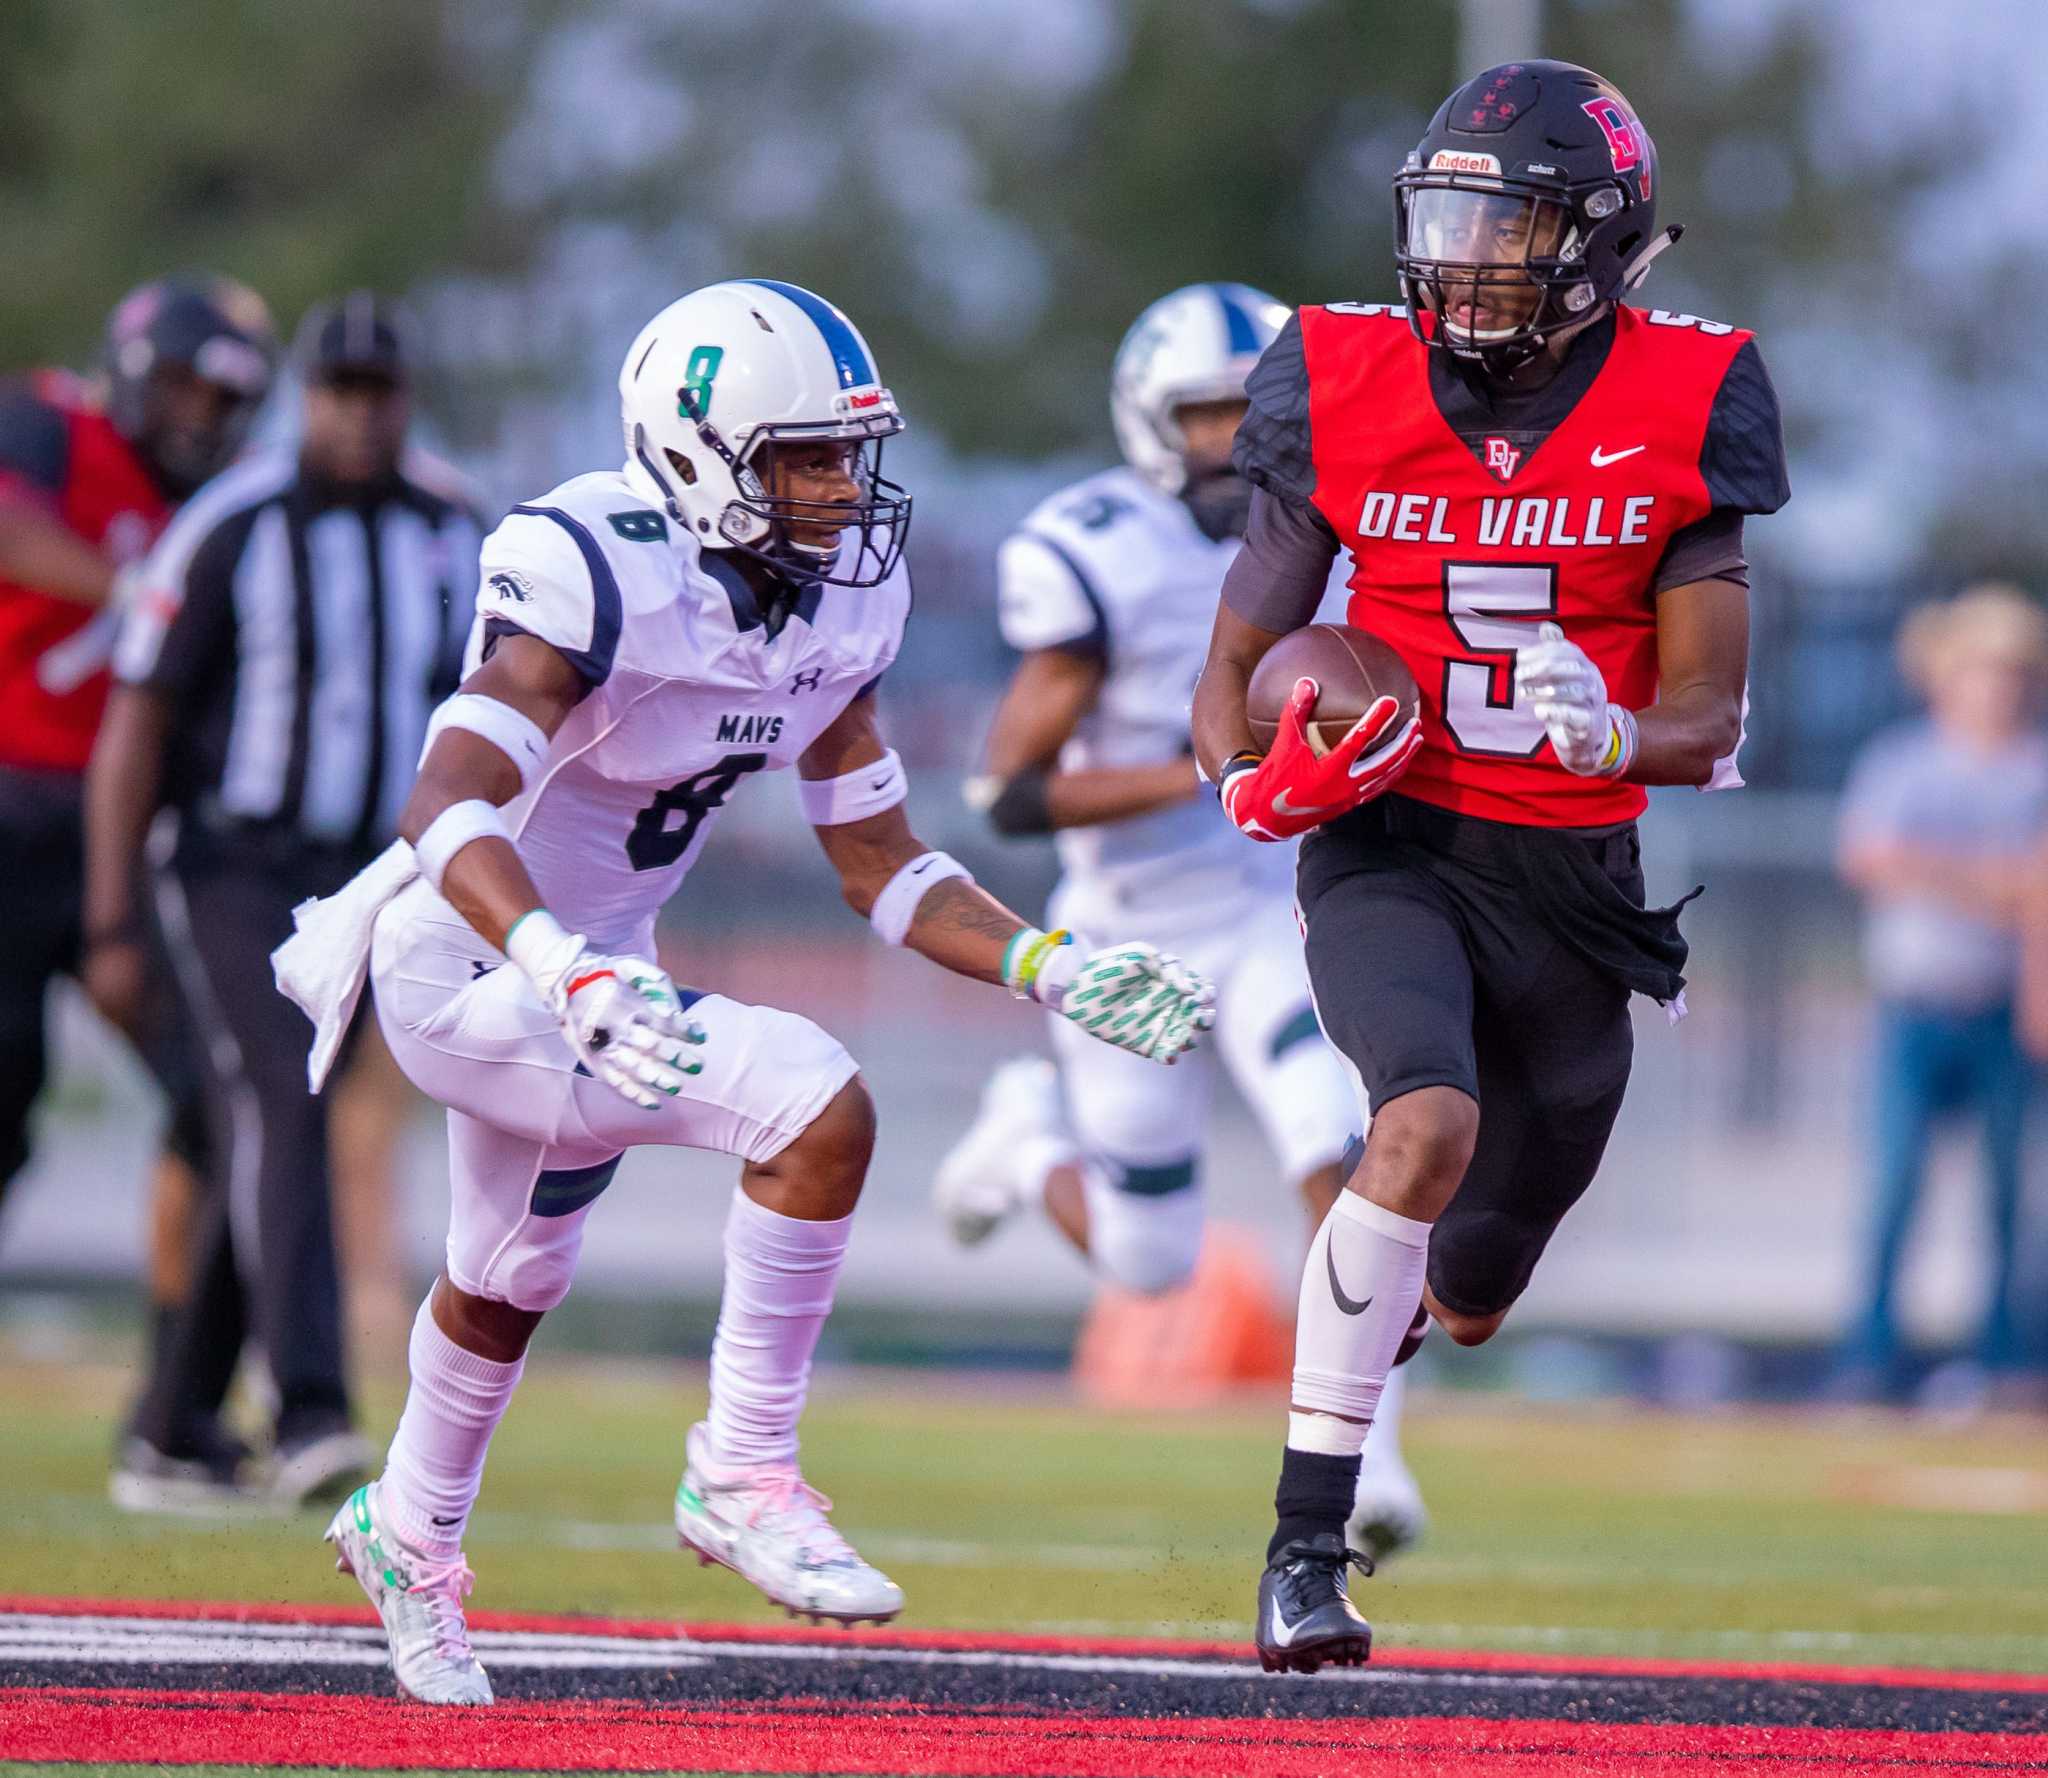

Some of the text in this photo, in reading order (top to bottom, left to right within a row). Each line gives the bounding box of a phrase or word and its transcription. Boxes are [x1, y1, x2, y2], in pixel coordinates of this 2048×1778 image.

[1435, 154, 1490, 171] Riddell
[675, 345, 724, 418] 8
[1486, 438, 1520, 479] DV
[607, 509, 669, 543] 8
[1357, 491, 1656, 546] DEL VALLE
[1441, 559, 1559, 759] 5
[716, 714, 783, 744] MAVS
[625, 753, 767, 872] 8
